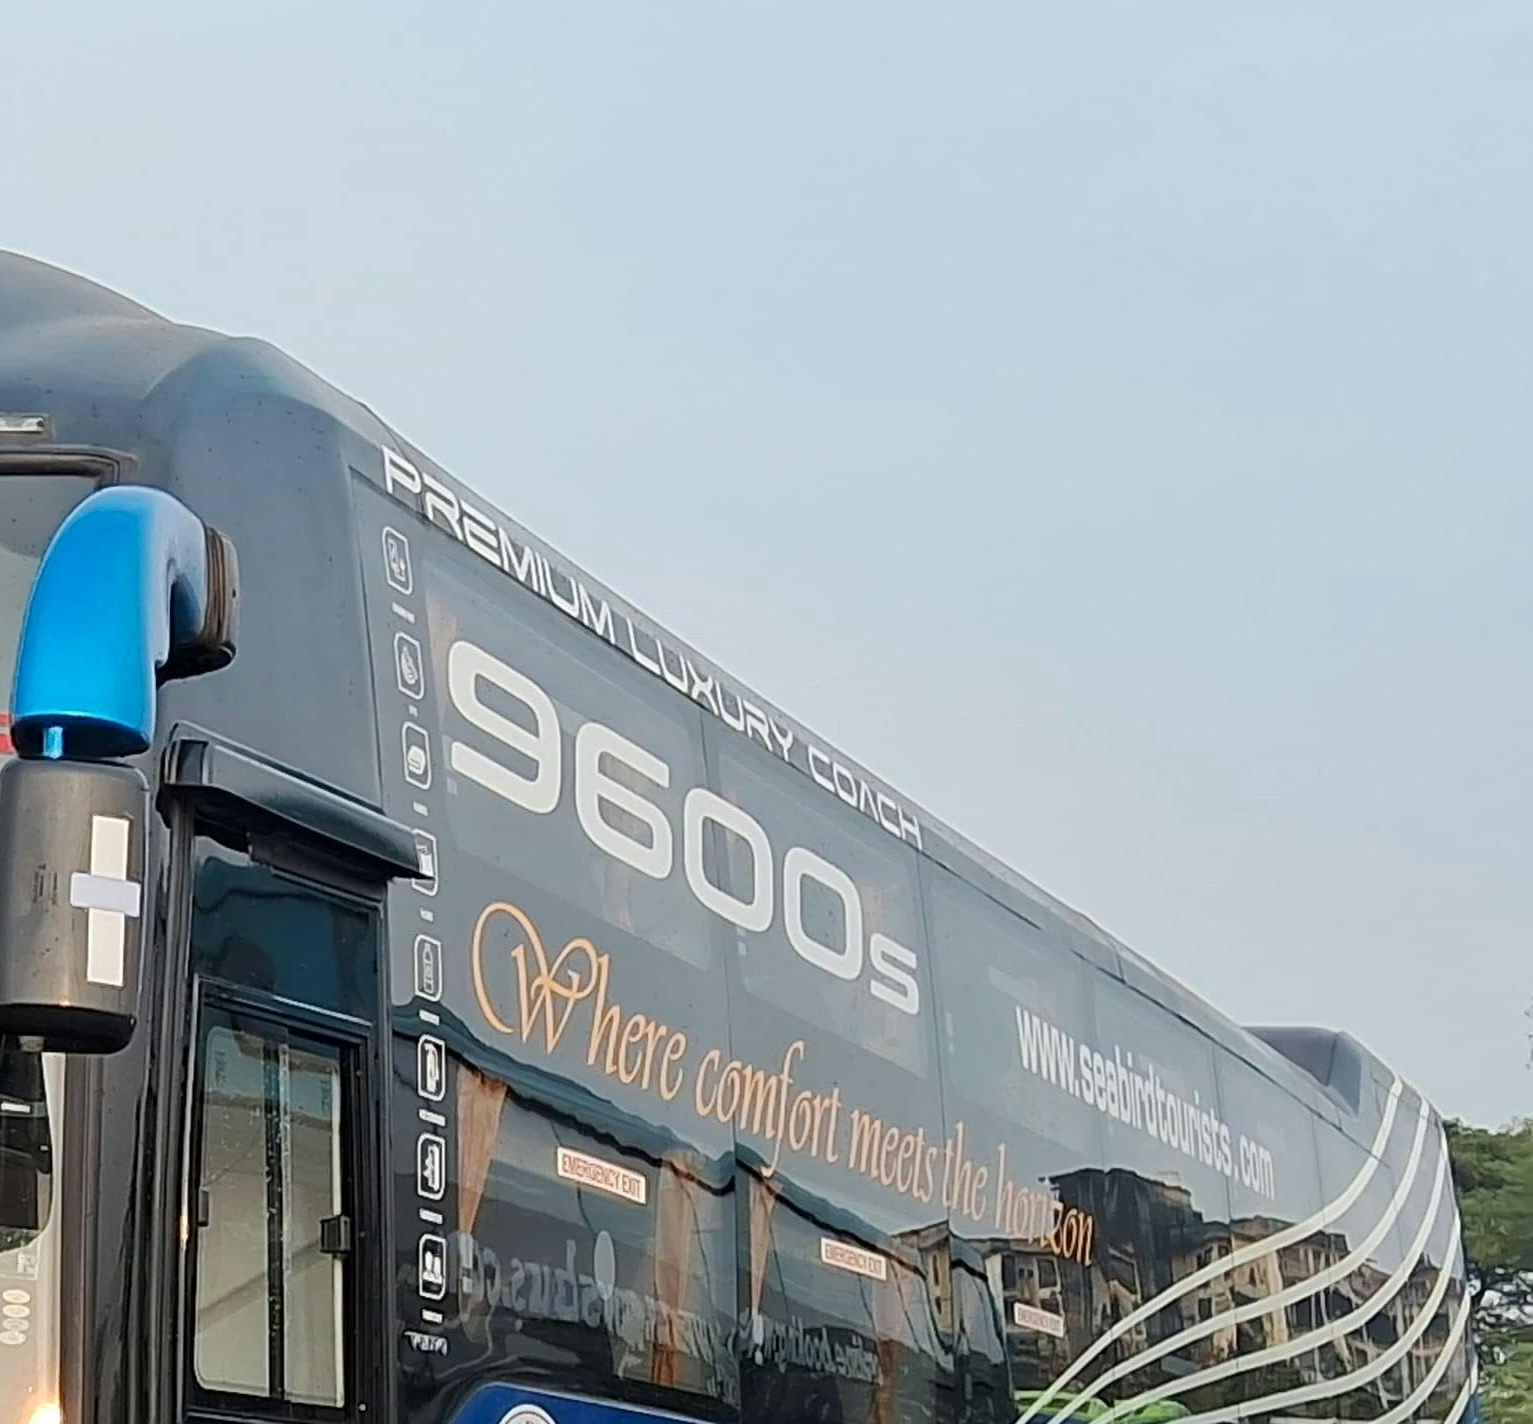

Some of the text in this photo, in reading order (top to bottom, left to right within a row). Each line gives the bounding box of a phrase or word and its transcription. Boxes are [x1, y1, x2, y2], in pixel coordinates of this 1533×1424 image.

[381, 446, 924, 851] PREMIUM LUXURY COACH
[472, 901, 1094, 1267] Where comfort meets the horizon
[1015, 1005, 1275, 1201] www.seabirdtourists.com
